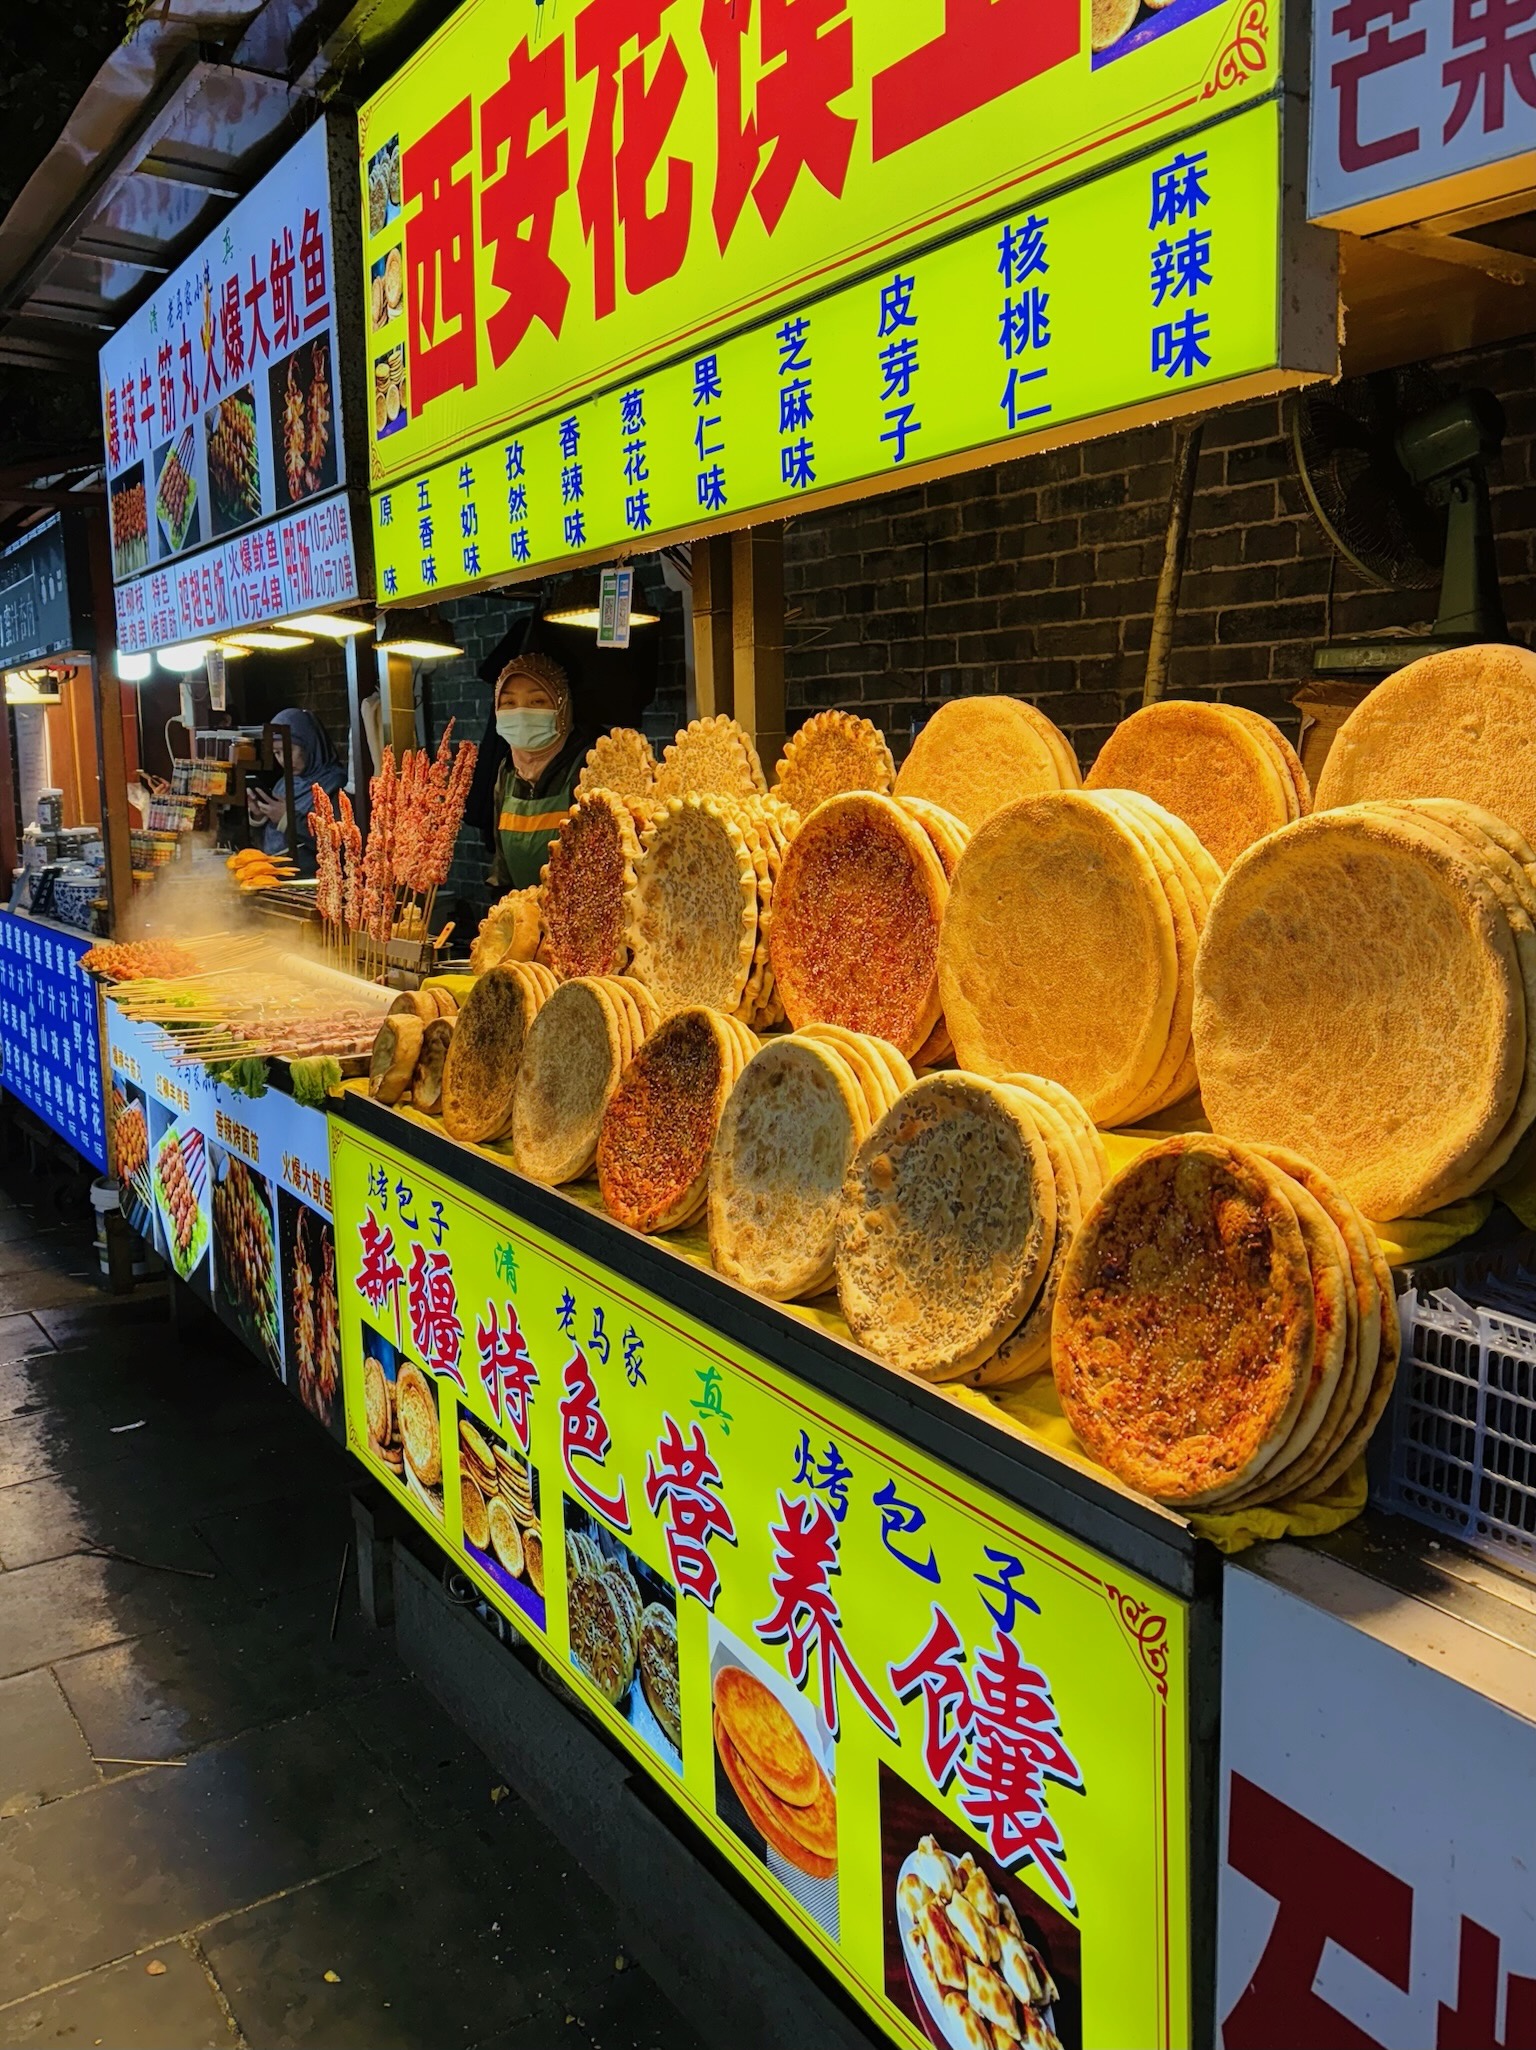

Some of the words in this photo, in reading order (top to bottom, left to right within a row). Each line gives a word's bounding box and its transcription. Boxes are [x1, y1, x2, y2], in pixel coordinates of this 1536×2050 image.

[1147, 150, 1213, 379] 麻辣味
[876, 274, 921, 463] 皮芽子
[996, 214, 1052, 430] 核桃仁
[692, 354, 728, 511] 果仁味
[775, 317, 816, 488] 芝麻味
[504, 440, 531, 563] 孜然味
[559, 415, 587, 548] 香辣味
[619, 388, 652, 532] 葱花味
[229, 529, 280, 581] 火爆鱿鱼
[416, 480, 437, 587] 五香味
[458, 462, 481, 577] 牛奶味
[119, 616, 147, 651] 羊肉串
[151, 573, 171, 608] 特色
[232, 574, 283, 622] 10元4串
[215, 1108, 260, 1164] 香辣烤面筋
[282, 1150, 333, 1214] 火爆大鱿鱼
[367, 1162, 450, 1246] 烤包子
[491, 1241, 521, 1295] 清
[555, 1286, 647, 1386] 老马家
[688, 1364, 735, 1437] 真
[792, 1430, 1042, 1633] 烤包子
